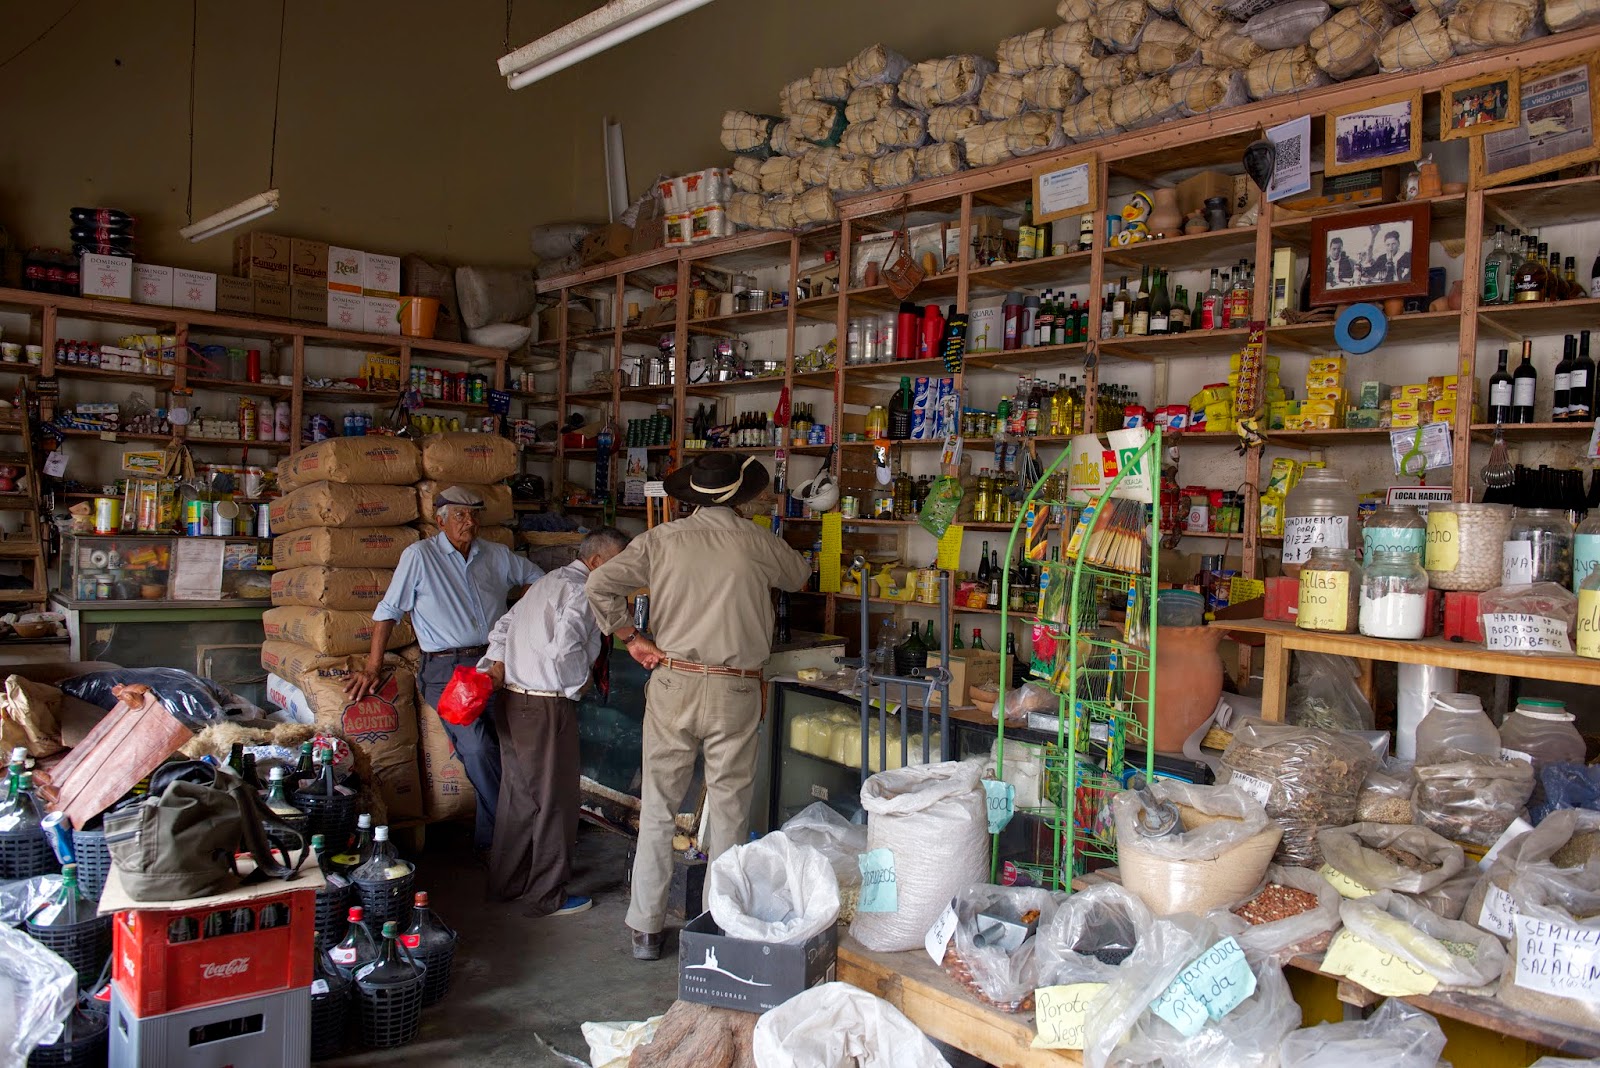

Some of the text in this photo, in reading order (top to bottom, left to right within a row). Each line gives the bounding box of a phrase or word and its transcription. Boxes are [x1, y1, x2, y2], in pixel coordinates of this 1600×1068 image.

[90, 257, 127, 267] DOMINGO
[134, 266, 168, 276] DOMINGO
[336, 260, 359, 276] Real
[178, 272, 212, 281] DOMINGO
[972, 309, 995, 319] QUARA
[370, 356, 401, 366] AJEDRE
[1395, 492, 1453, 501] LOCAL HABILITA
[1301, 590, 1327, 604] Lino
[1493, 614, 1534, 623] HARINA
[358, 702, 381, 716] SAN
[346, 717, 396, 733] AGUSTIN
[200, 957, 250, 979] Coca-Cola
[685, 973, 707, 982] Bodega
[685, 986, 748, 1001] TIERRA COLORADA
